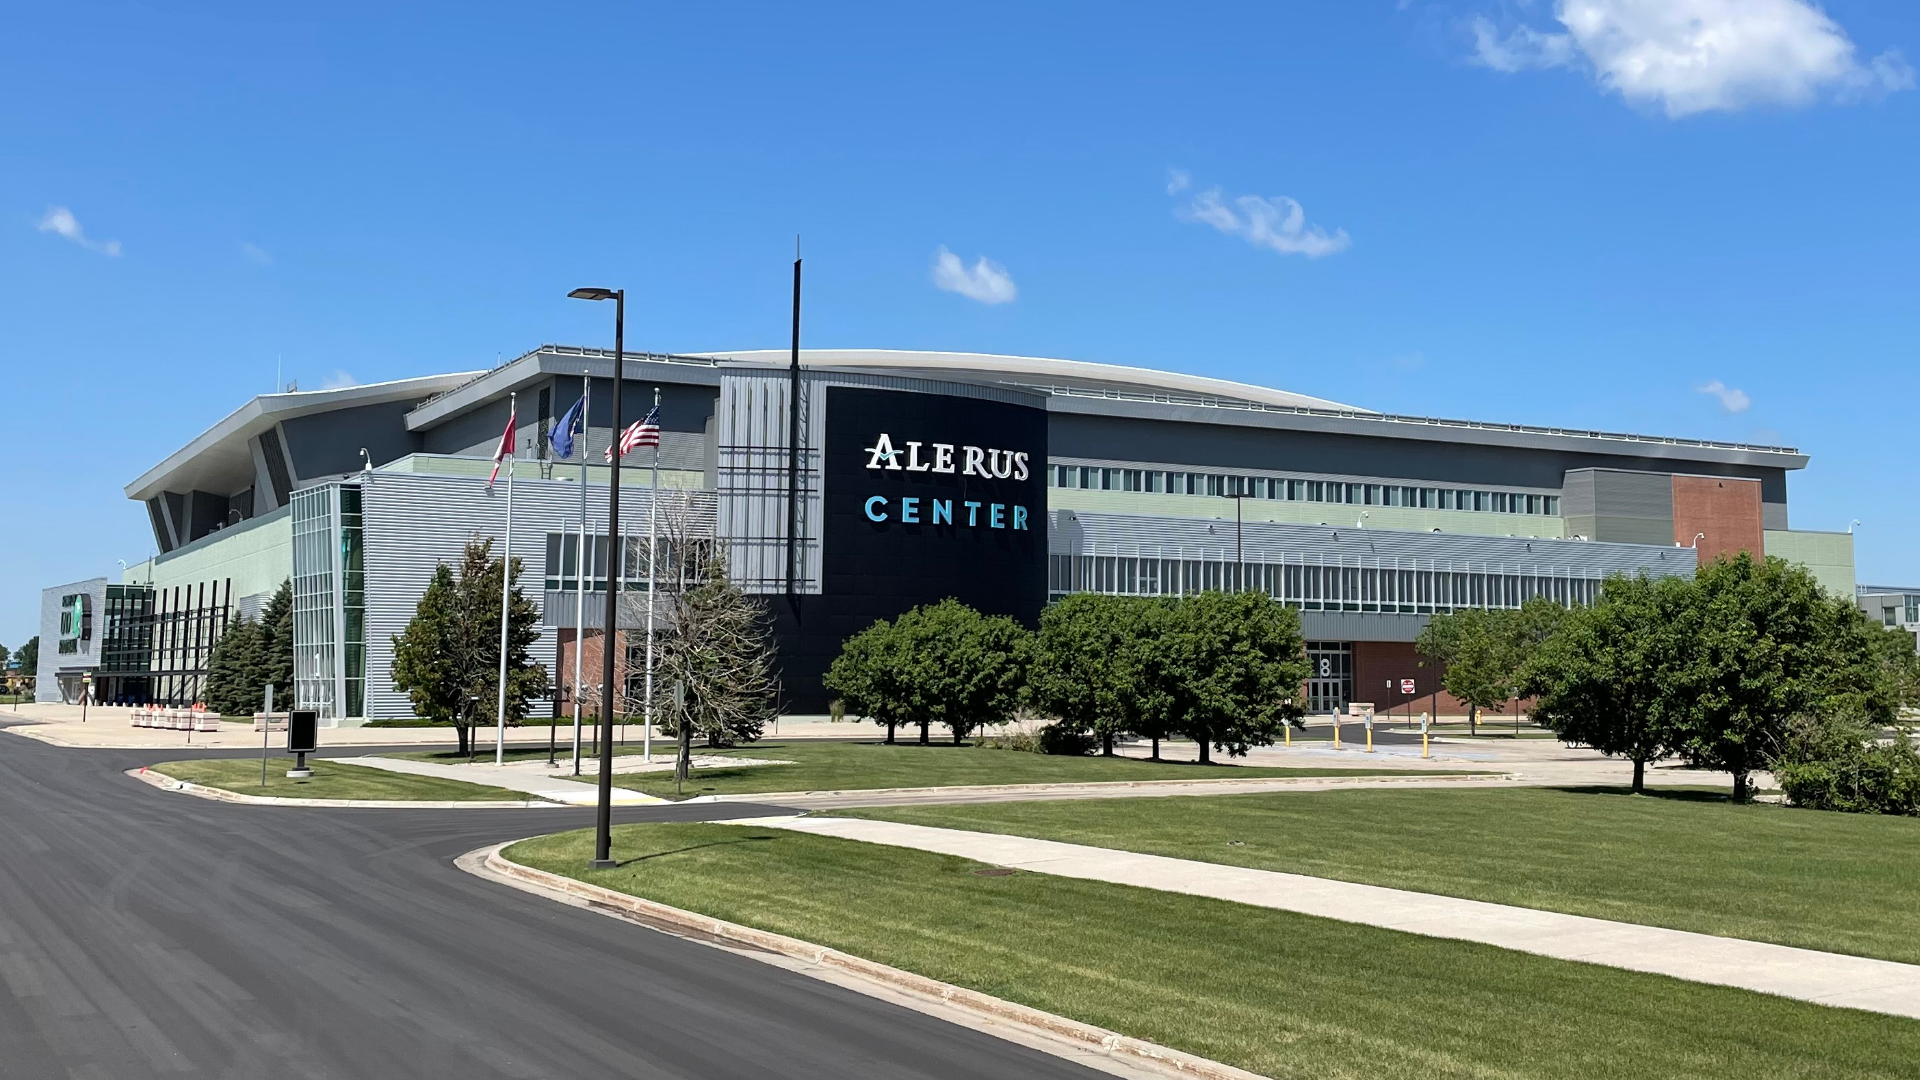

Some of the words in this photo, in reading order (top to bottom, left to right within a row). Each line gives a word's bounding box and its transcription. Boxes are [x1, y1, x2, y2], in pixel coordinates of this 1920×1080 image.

[864, 433, 1029, 481] ALERUS
[864, 495, 1029, 530] CENTER
[1320, 658, 1330, 676] 8
